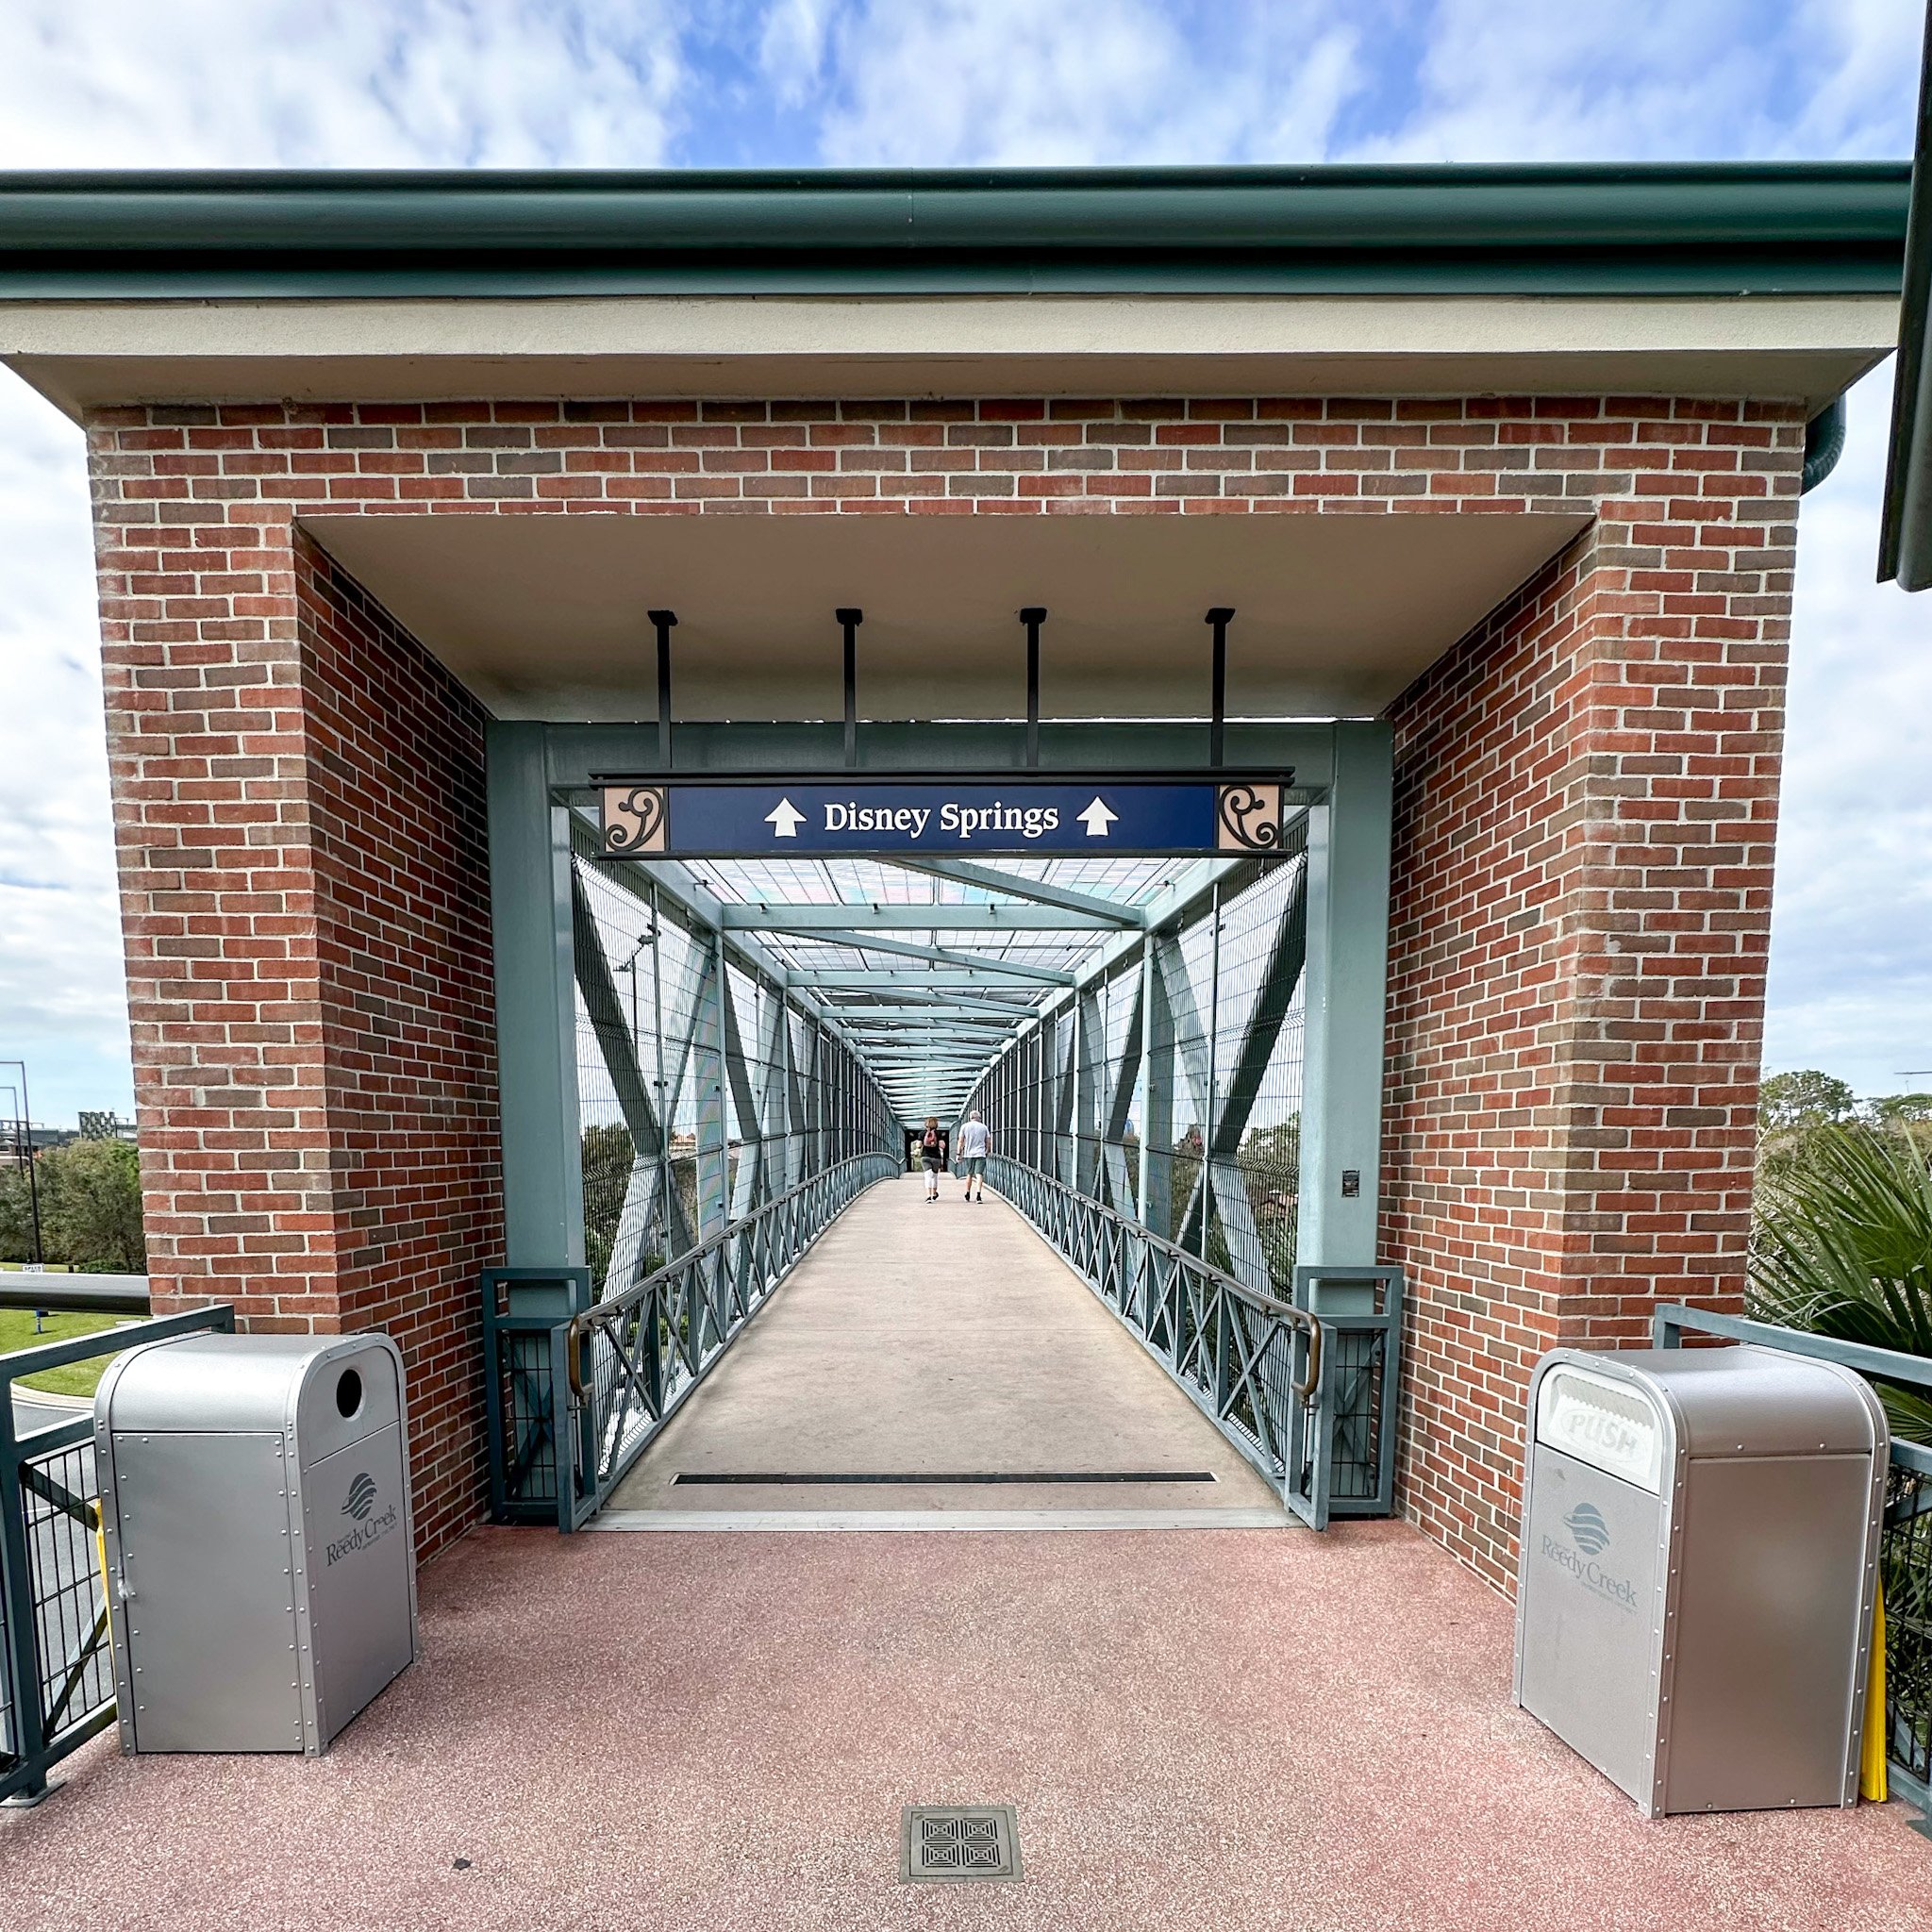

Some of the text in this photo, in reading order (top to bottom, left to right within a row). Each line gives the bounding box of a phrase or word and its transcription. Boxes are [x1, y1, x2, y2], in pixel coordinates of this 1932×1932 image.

[824, 801, 1059, 839] Disney Springs
[1568, 1414, 1638, 1457] PUSH
[325, 1527, 364, 1567] Reedy
[364, 1504, 396, 1539] Creek
[1541, 1534, 1586, 1578] Reedy
[1587, 1561, 1638, 1607] Creek
